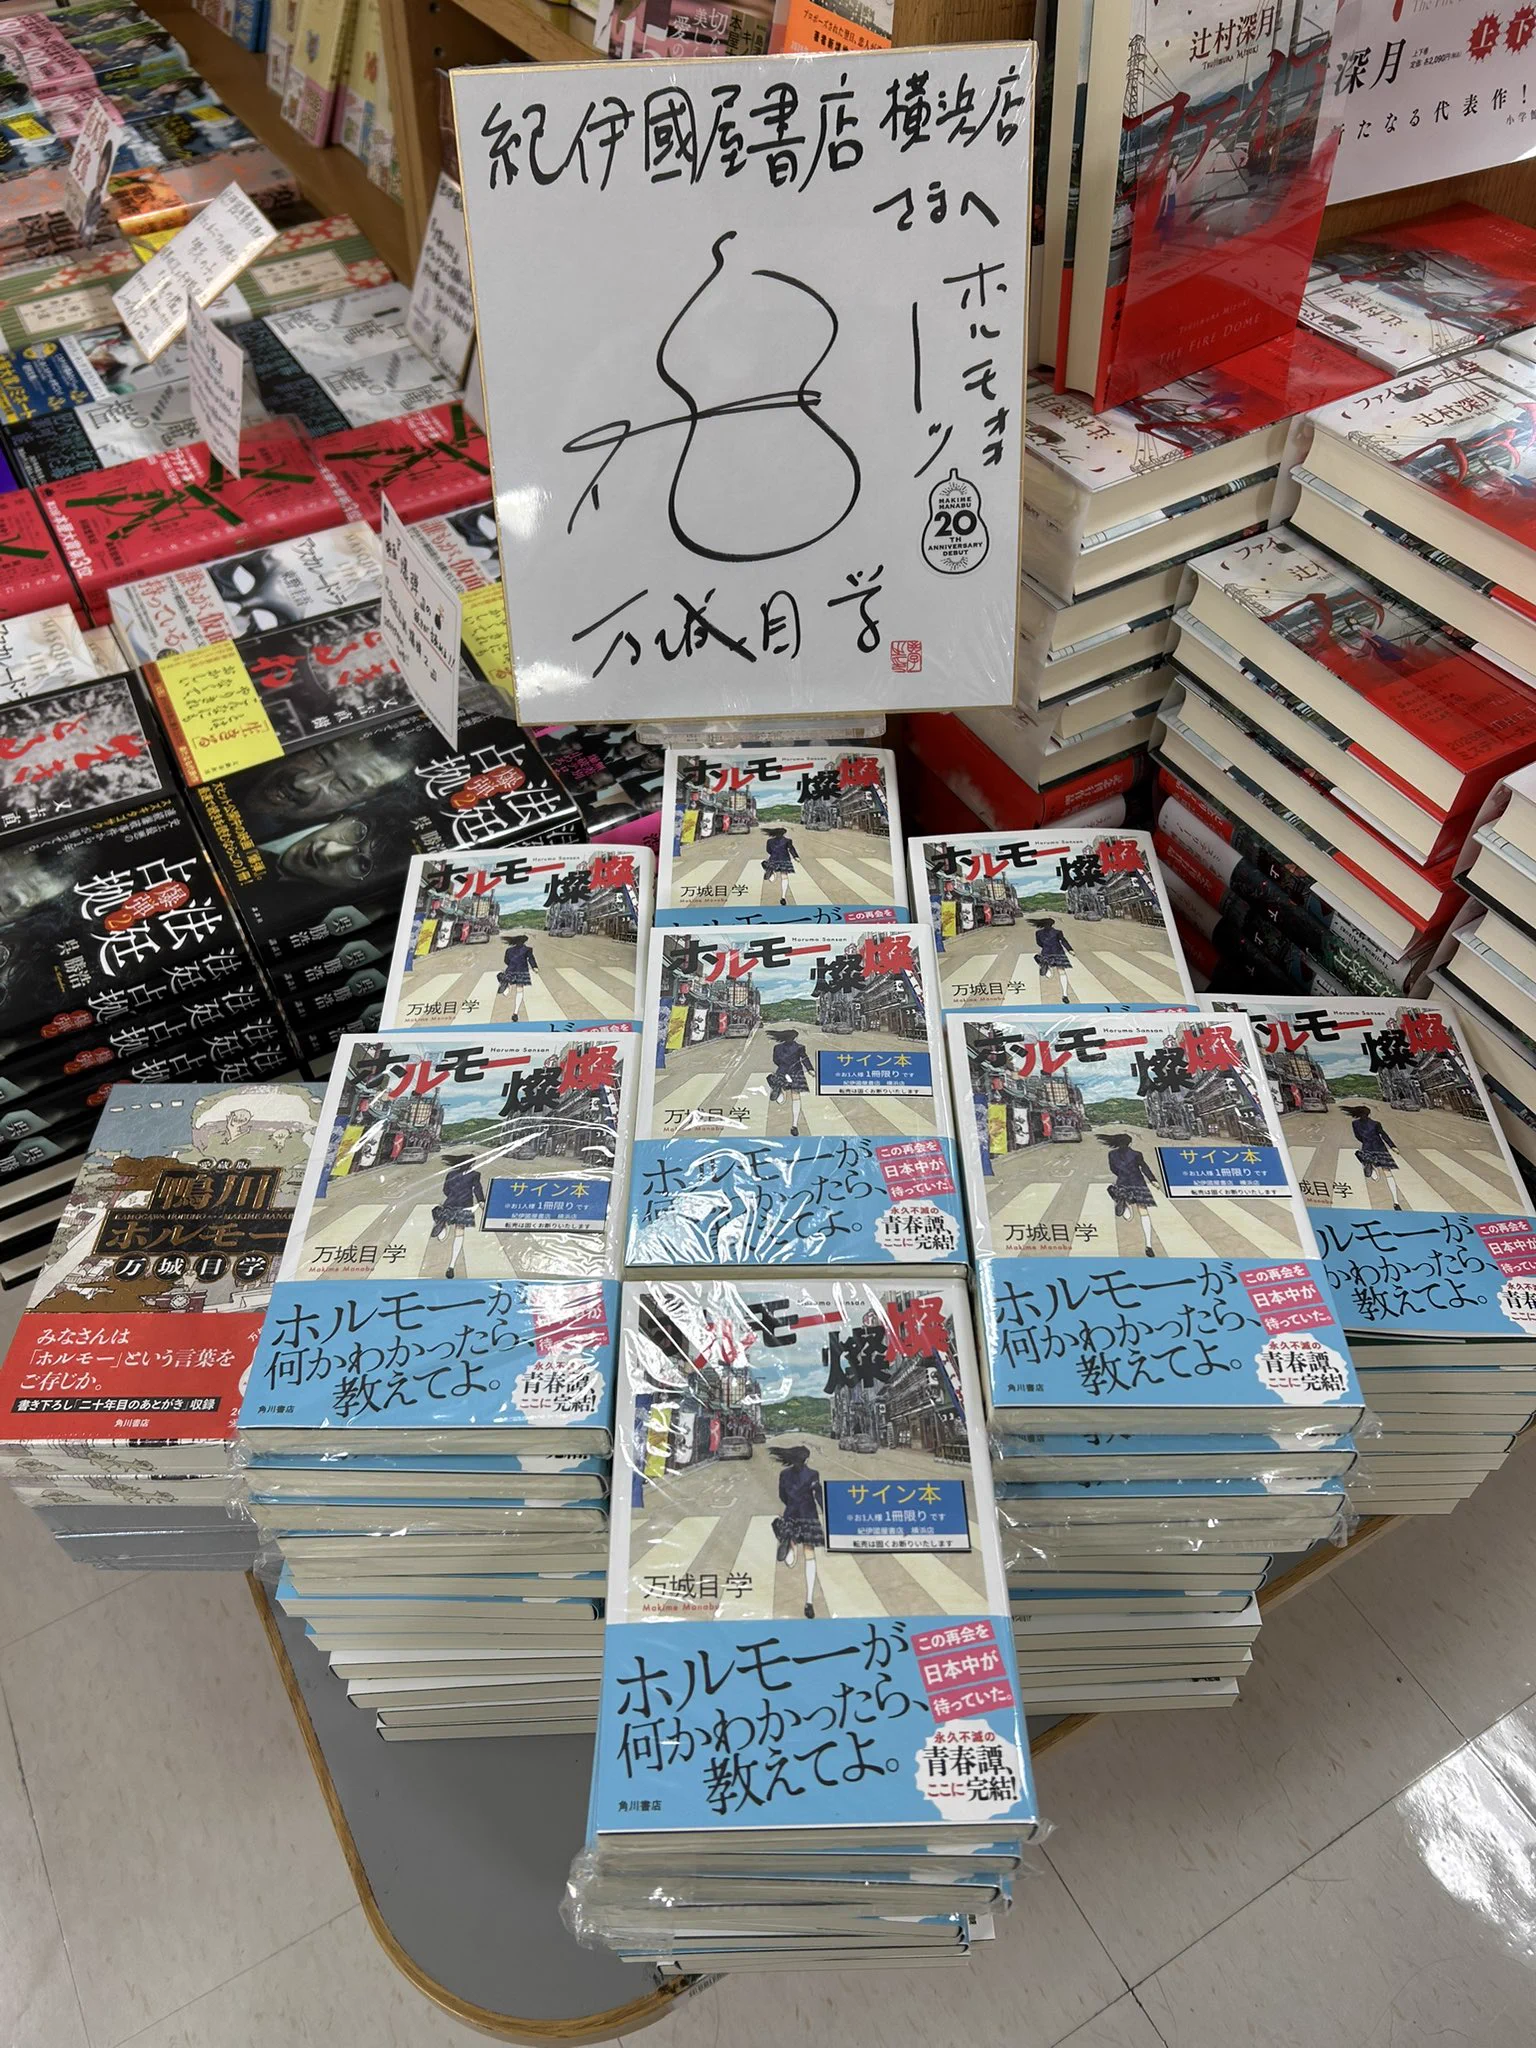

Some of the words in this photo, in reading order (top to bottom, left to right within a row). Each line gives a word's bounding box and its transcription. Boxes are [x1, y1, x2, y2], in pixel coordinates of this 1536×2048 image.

[1189, 5, 1275, 62] 辻村深月
[1472, 22, 1495, 51] 上
[1514, 15, 1535, 43] 下
[480, 73, 865, 191] 紀伊國屋書店
[879, 64, 1027, 151] 横浜店
[872, 182, 1001, 231] さまへ
[1413, 391, 1500, 428] 辻村深月
[938, 496, 973, 504] MAKIME
[934, 509, 978, 537] 20
[928, 542, 983, 550] ANNIVERSARY
[942, 549, 969, 557] DEBUT
[413, 729, 533, 804] 占拠
[70, 840, 205, 924] 占拠
[89, 888, 230, 980] 法廷
[836, 1054, 911, 1067] サイン本
[881, 1142, 937, 1156] この再会を
[1180, 1149, 1262, 1165] サイン本
[199, 1159, 251, 1170] 愛蔵版
[884, 1159, 944, 1178] 日本中が
[159, 1175, 274, 1209] 鴨川
[510, 1183, 589, 1198] サイン本
[890, 1180, 955, 1198] 待っていた。
[891, 1206, 939, 1215] 永久不滅の
[105, 1222, 289, 1249] ホルモー
[881, 1214, 950, 1236] 青春譚、
[1479, 1220, 1530, 1237] この再会を
[884, 1233, 955, 1252] ここに完結!
[116, 1257, 267, 1277] 万城目学
[1245, 1266, 1306, 1285] この再会を
[995, 1259, 1237, 1325] ホルモーが
[1253, 1285, 1316, 1308] 日本中が
[1351, 1279, 1489, 1324] 教えてよ。
[274, 1282, 528, 1347] ホルモーが
[1264, 1310, 1333, 1329] 待っていた。
[37, 1328, 130, 1345] みなさんは
[1000, 1299, 1263, 1369] 何かわかったら、
[266, 1316, 536, 1391] 何かわかったら、
[1268, 1341, 1322, 1352] 永久不滅の
[28, 1350, 235, 1368] 「ホルモー」という言葉を
[1078, 1343, 1243, 1396] 教えてよ。
[1261, 1351, 1340, 1376] 青春譚、
[20, 1374, 103, 1392] ご存じか。
[332, 1360, 501, 1419] 教えてよ。
[1007, 1384, 1045, 1394] 角川書店
[1268, 1373, 1347, 1394] ここに完結!
[17, 1399, 216, 1412] 書き下ろし「二十年目のあとがき」収録
[257, 1405, 295, 1415] 角川書店
[114, 1419, 151, 1428] 角川書店
[847, 1484, 943, 1505] サイン本
[852, 1539, 954, 1549] 転売は固くお断りいたします
[917, 1624, 991, 1650] この再会を
[616, 1621, 909, 1717] ホルモーが
[924, 1652, 1000, 1685] 日本中が
[932, 1685, 1014, 1715] 待っていた。
[616, 1674, 931, 1780] 何かわかったら、
[934, 1729, 996, 1743] 永久不滅の
[922, 1743, 1016, 1777] 青春譚、
[702, 1734, 901, 1816] 教えてよ。
[927, 1774, 1019, 1804] ここに完結!
[617, 1800, 662, 1813] 角川書店
